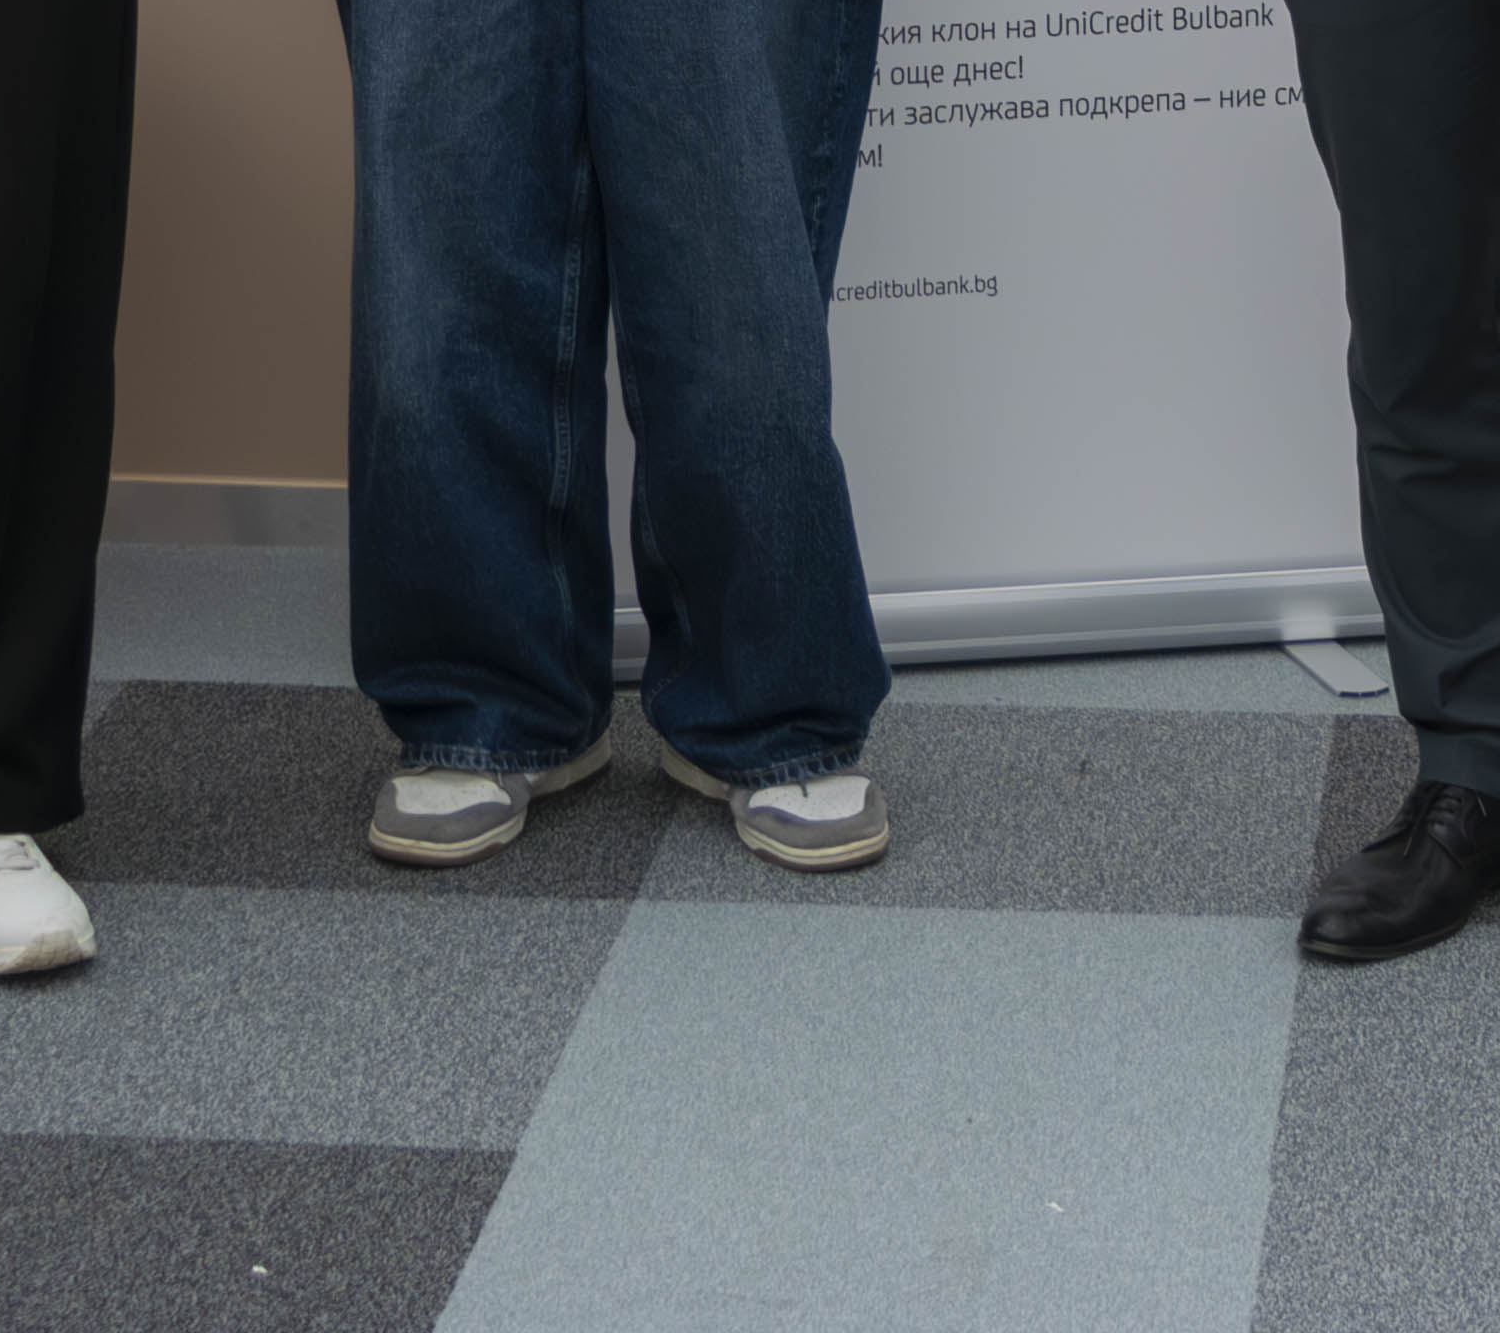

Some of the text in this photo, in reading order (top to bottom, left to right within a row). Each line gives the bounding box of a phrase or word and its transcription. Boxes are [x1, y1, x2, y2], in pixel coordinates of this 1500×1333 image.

[932, 20, 996, 42] клон
[1005, 17, 1037, 39] на
[1046, 7, 1163, 38] UniCredit
[1173, 2, 1275, 32] Bulbank
[890, 63, 945, 89] още
[953, 55, 1024, 87] днес!
[903, 99, 1049, 128] заслужава
[1059, 90, 1186, 120] подкрепа
[1219, 85, 1266, 109] ние
